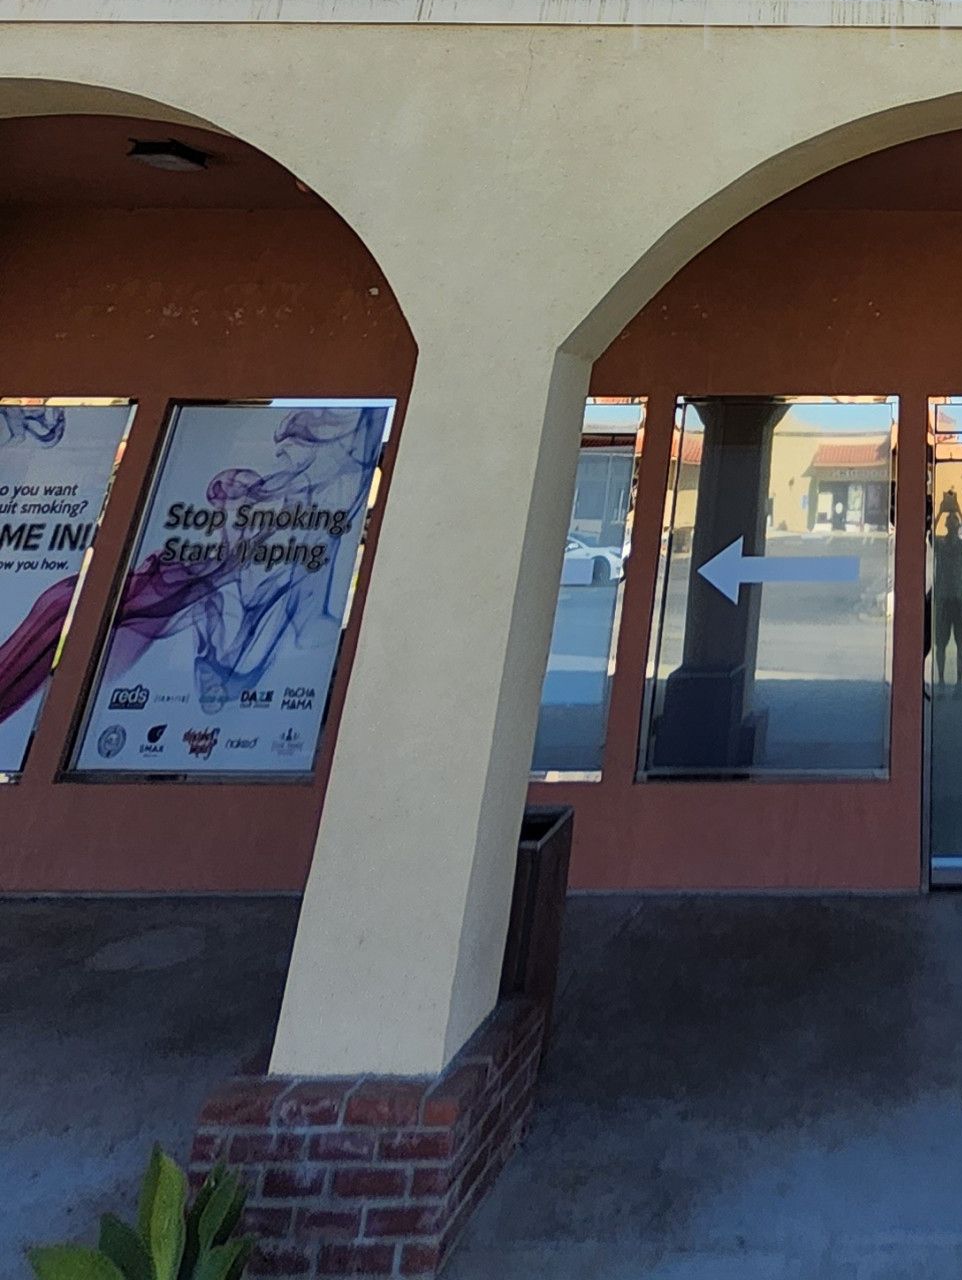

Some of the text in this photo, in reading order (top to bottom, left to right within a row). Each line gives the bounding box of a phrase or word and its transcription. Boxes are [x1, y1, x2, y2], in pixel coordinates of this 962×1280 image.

[11, 485, 40, 499] you
[43, 484, 79, 497] want
[20, 499, 89, 518] smoking?
[163, 502, 228, 536] Stop
[47, 523, 94, 551] IN!
[162, 536, 331, 572] Start Vaping.
[15, 561, 39, 573] you
[40, 558, 69, 570] how.
[112, 686, 148, 703] reds
